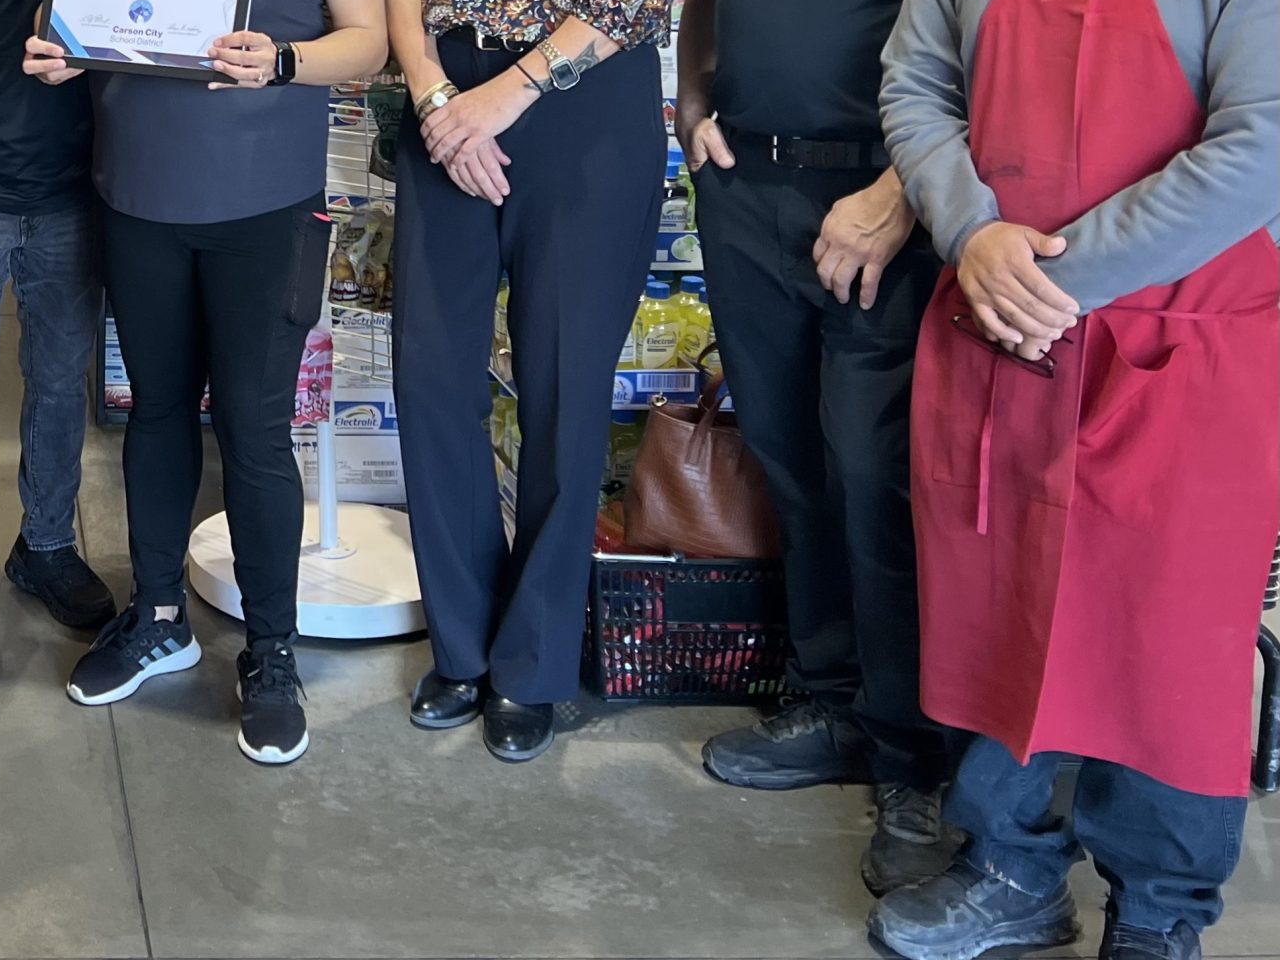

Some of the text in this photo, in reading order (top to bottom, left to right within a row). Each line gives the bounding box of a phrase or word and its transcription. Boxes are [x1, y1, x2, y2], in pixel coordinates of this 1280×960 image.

[112, 25, 145, 36] Carson
[145, 27, 164, 39] City
[109, 35, 164, 47] School District
[334, 416, 379, 427] Electrolit
